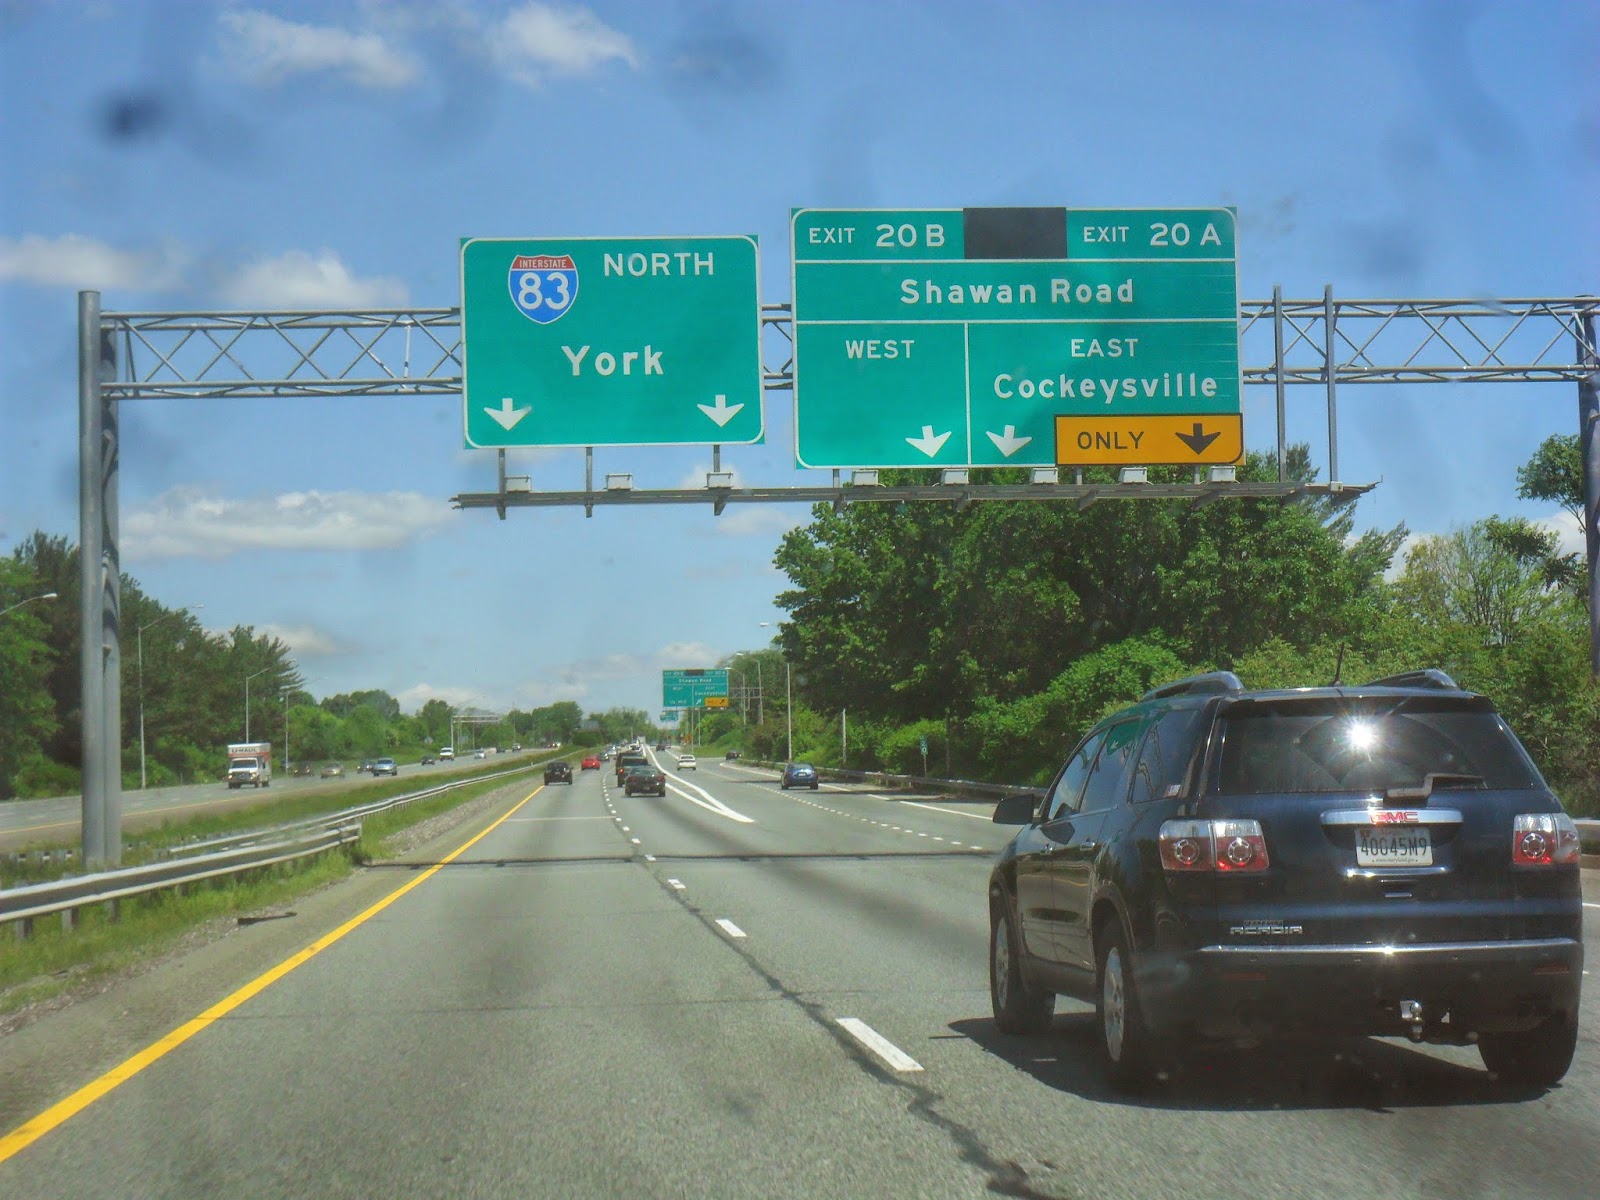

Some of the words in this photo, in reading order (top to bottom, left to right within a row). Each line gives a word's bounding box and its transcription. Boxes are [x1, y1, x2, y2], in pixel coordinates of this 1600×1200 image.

[808, 227, 855, 244] EXIT
[1082, 226, 1129, 243] EXIT
[519, 257, 567, 269] INTERSTATE
[603, 251, 715, 277] NORTH
[518, 272, 569, 310] 83
[900, 279, 1036, 304] Shawan
[1050, 278, 1134, 303] Road
[845, 339, 915, 359] WEST
[1070, 338, 1139, 358] EAST
[561, 344, 664, 376] York
[993, 372, 1218, 404] Cockeysville
[1076, 431, 1145, 450] ONLY
[1370, 811, 1420, 823] GMC
[1230, 926, 1304, 935] ACADIA
